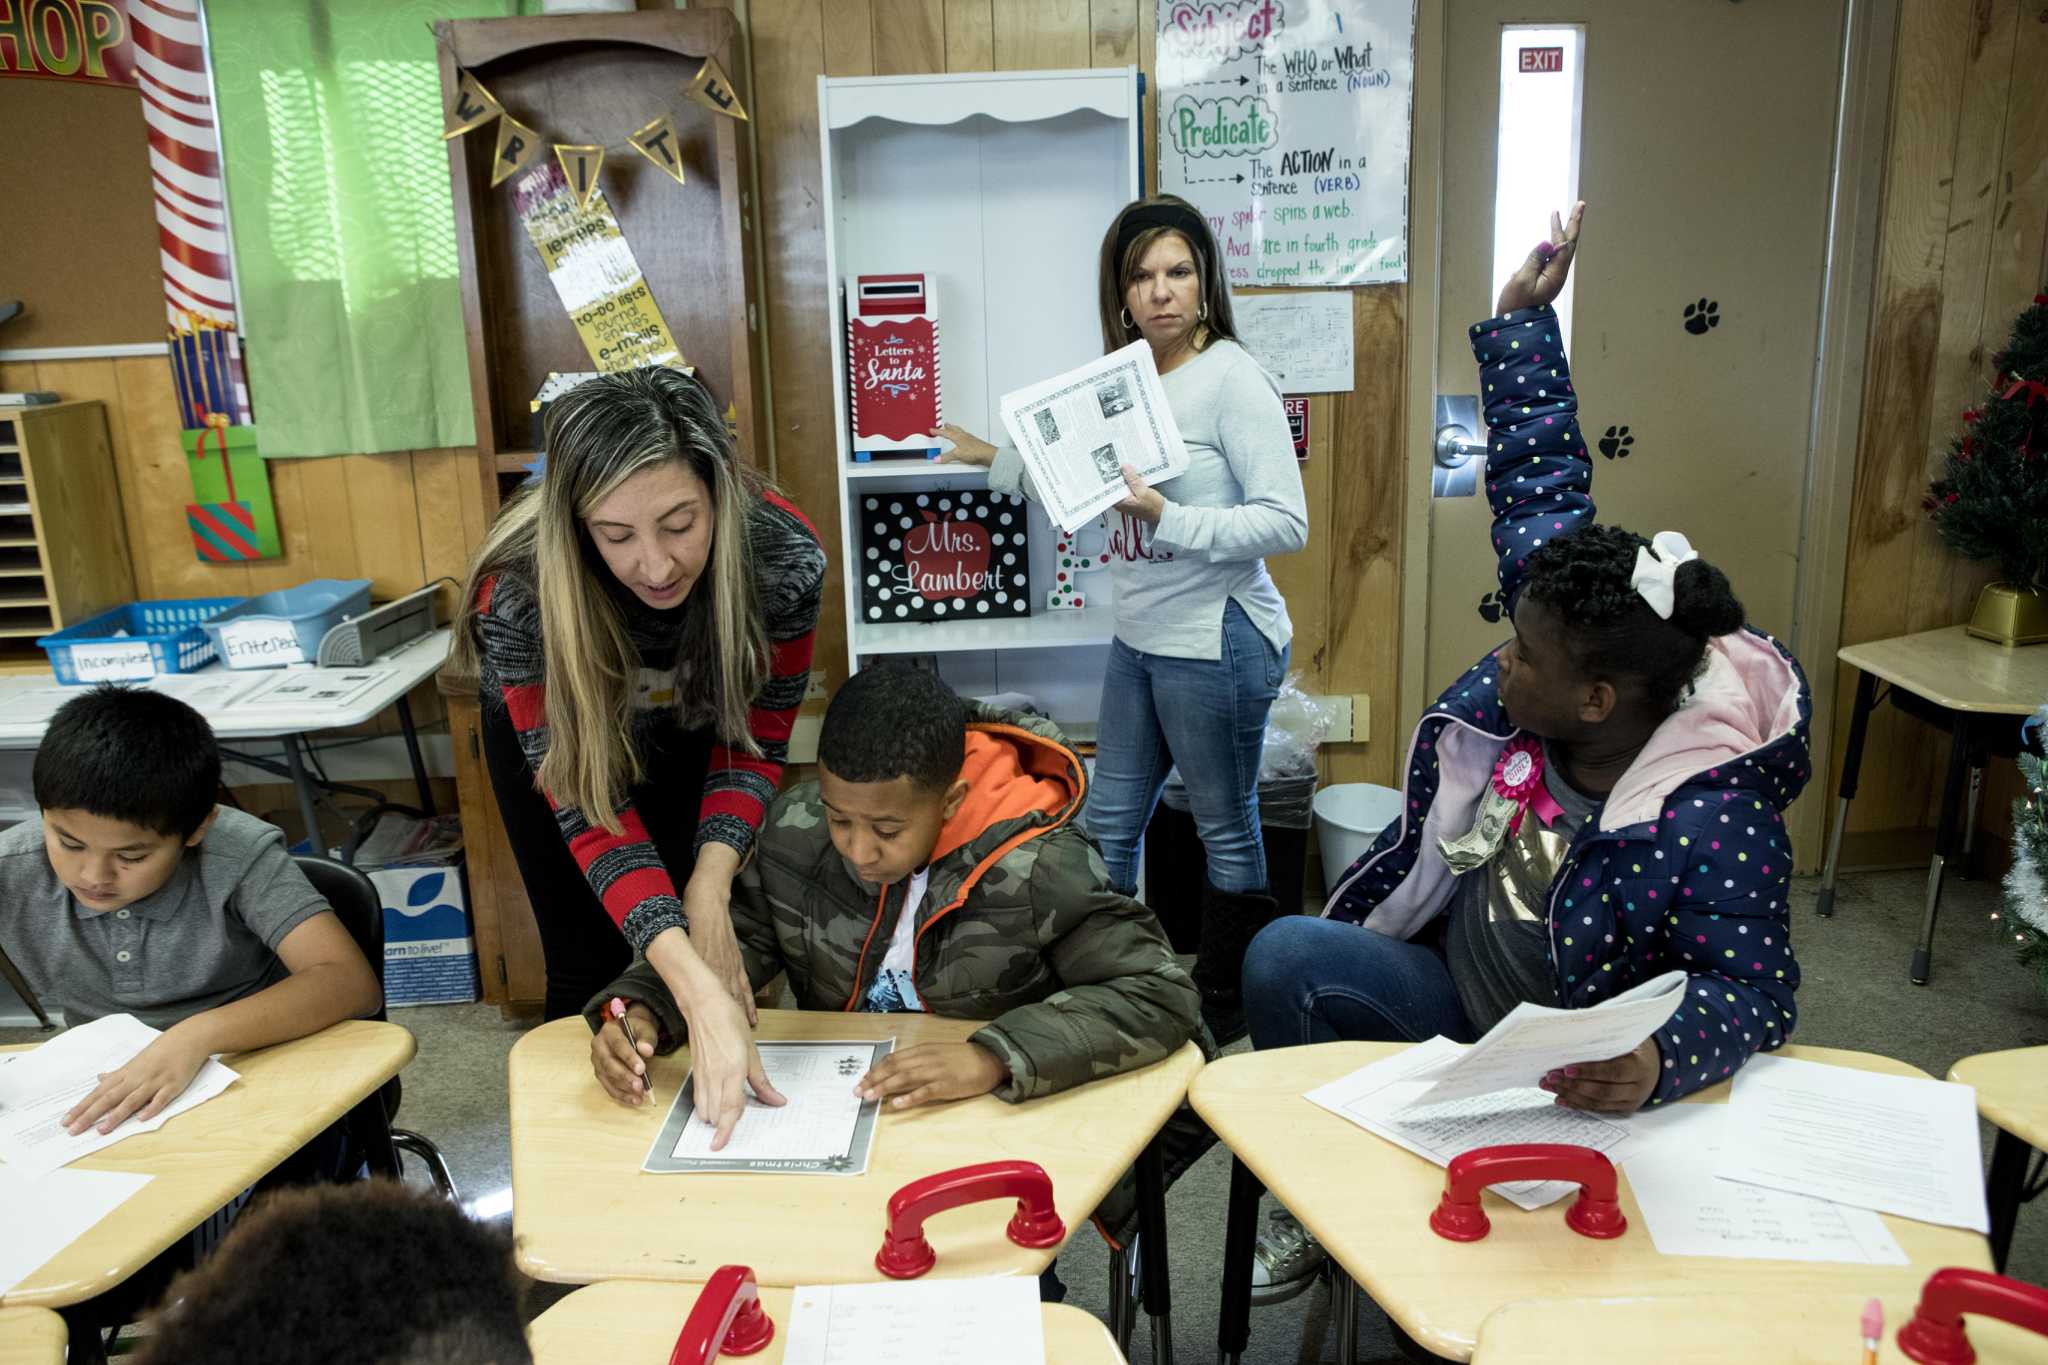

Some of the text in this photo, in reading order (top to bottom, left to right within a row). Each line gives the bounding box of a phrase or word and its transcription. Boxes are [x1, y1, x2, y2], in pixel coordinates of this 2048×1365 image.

[0, 0, 124, 78] HOP
[1254, 42, 1372, 75] The WHO or What
[1521, 50, 1560, 70] EXIT
[703, 79, 733, 110] E
[1288, 75, 1338, 92] sentence
[1347, 69, 1391, 93] (NOUN)
[456, 92, 485, 122] W
[1179, 105, 1270, 147] Predicate
[501, 135, 525, 164] R
[645, 129, 673, 165] T
[1250, 159, 1273, 178] The
[1280, 148, 1335, 176] ACTION
[1339, 157, 1351, 169] in
[1314, 173, 1360, 195] (VERB)
[1274, 206, 1306, 225] spins
[1227, 236, 1250, 256] Ava
[1287, 240, 1298, 253] in
[1305, 232, 1339, 252] fourth
[1257, 261, 1299, 284] dropped
[1380, 254, 1402, 271] food
[874, 345, 914, 357] Letters
[889, 357, 900, 365] to
[864, 358, 926, 390] Santa
[1285, 400, 1305, 415] RE
[907, 521, 981, 554] Mrs.
[891, 560, 1005, 595] Lambert
[226, 630, 298, 657] Entered
[77, 652, 151, 671] Incomplete
[749, 1159, 821, 1170] Christmas
